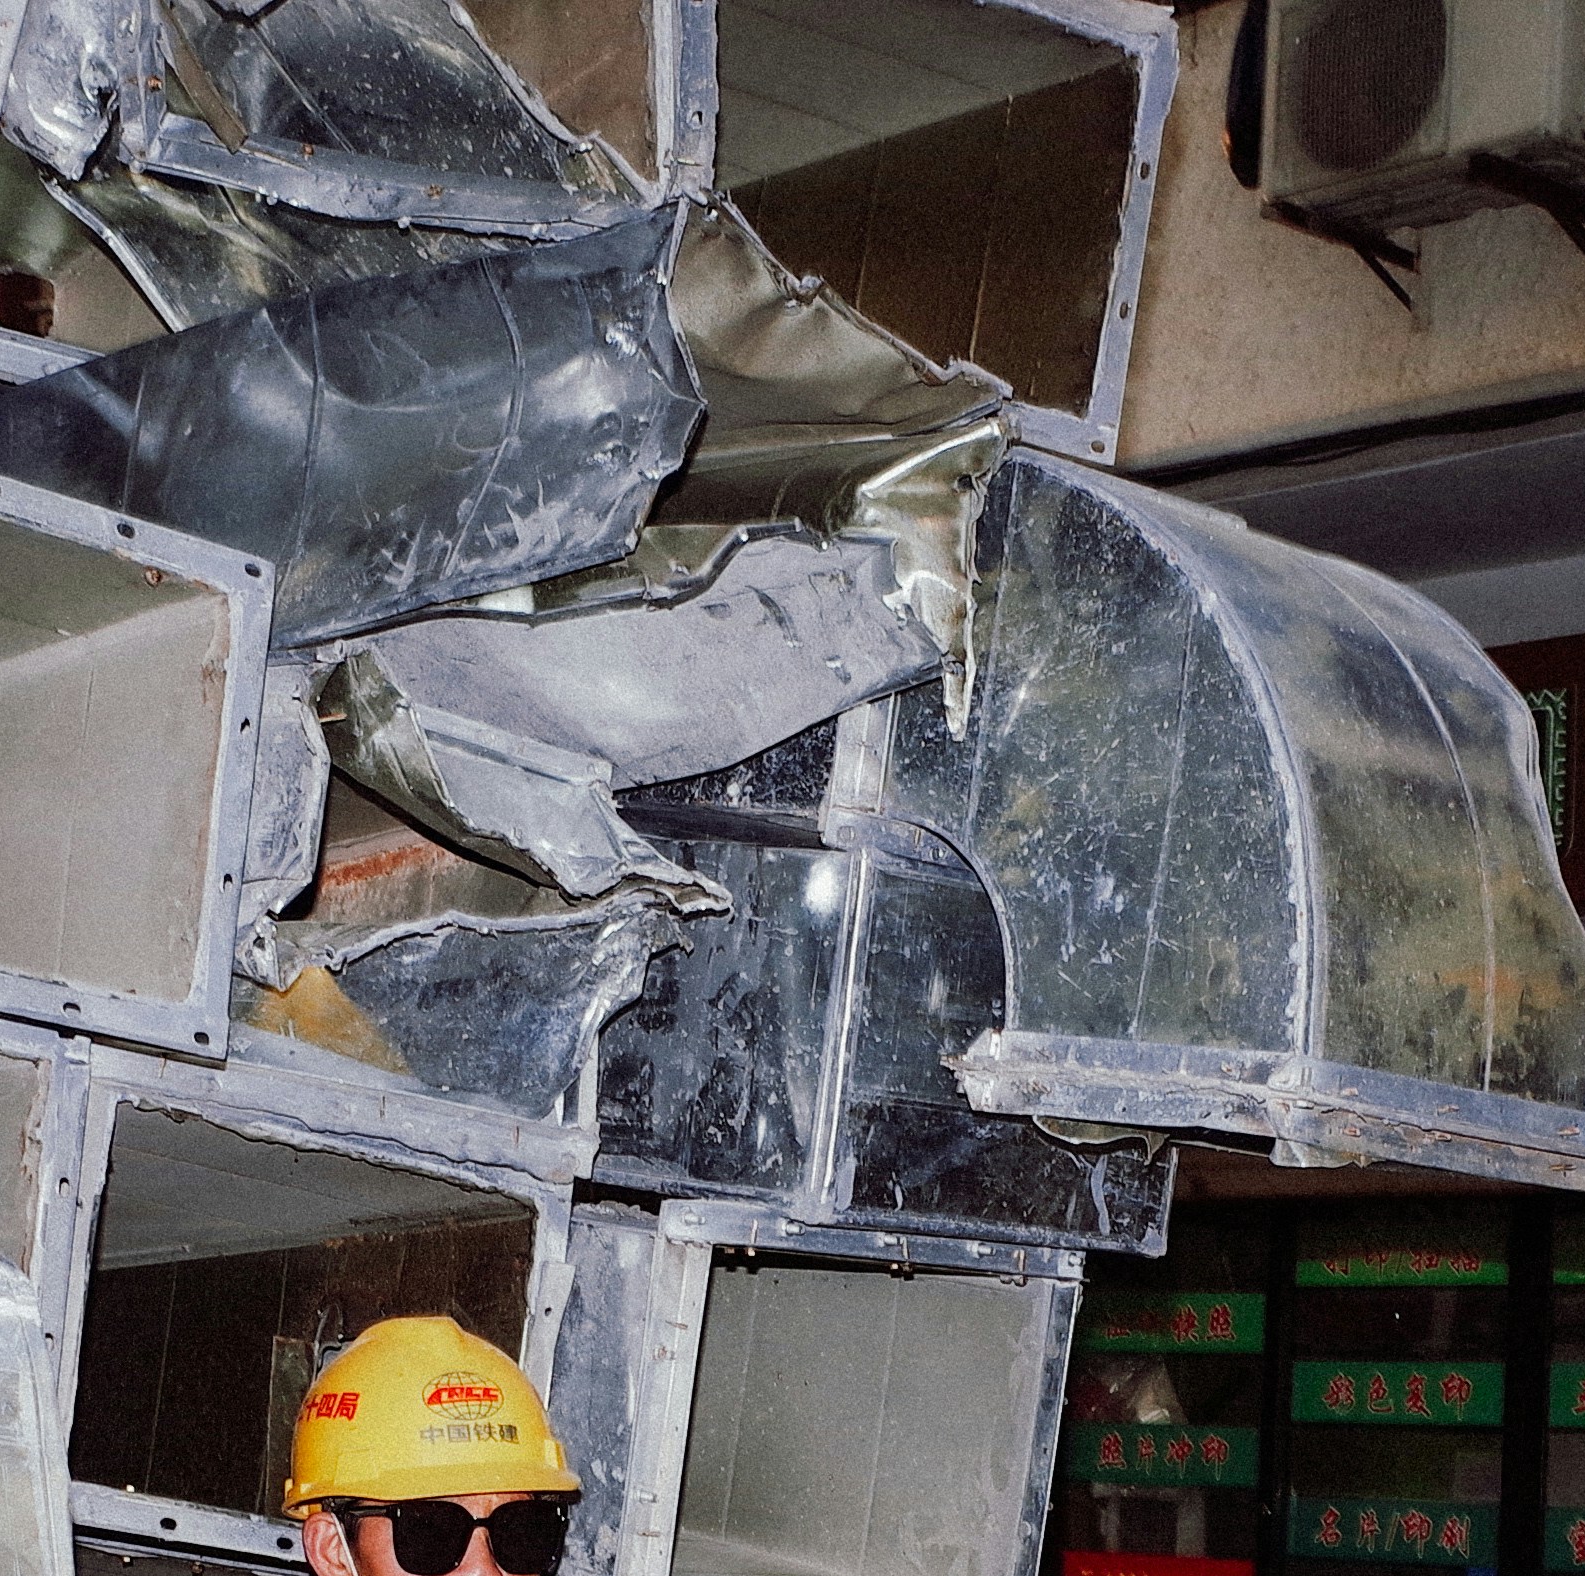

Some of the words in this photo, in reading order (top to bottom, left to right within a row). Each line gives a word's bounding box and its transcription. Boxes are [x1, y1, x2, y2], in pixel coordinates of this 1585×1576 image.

[298, 1391, 360, 1422] 十四局
[1322, 1371, 1474, 1421] 彩色复印
[420, 1421, 520, 1445] 中国铁建
[1097, 1430, 1230, 1482] 照片冲印
[1314, 1504, 1472, 1560] 名片/印刷
